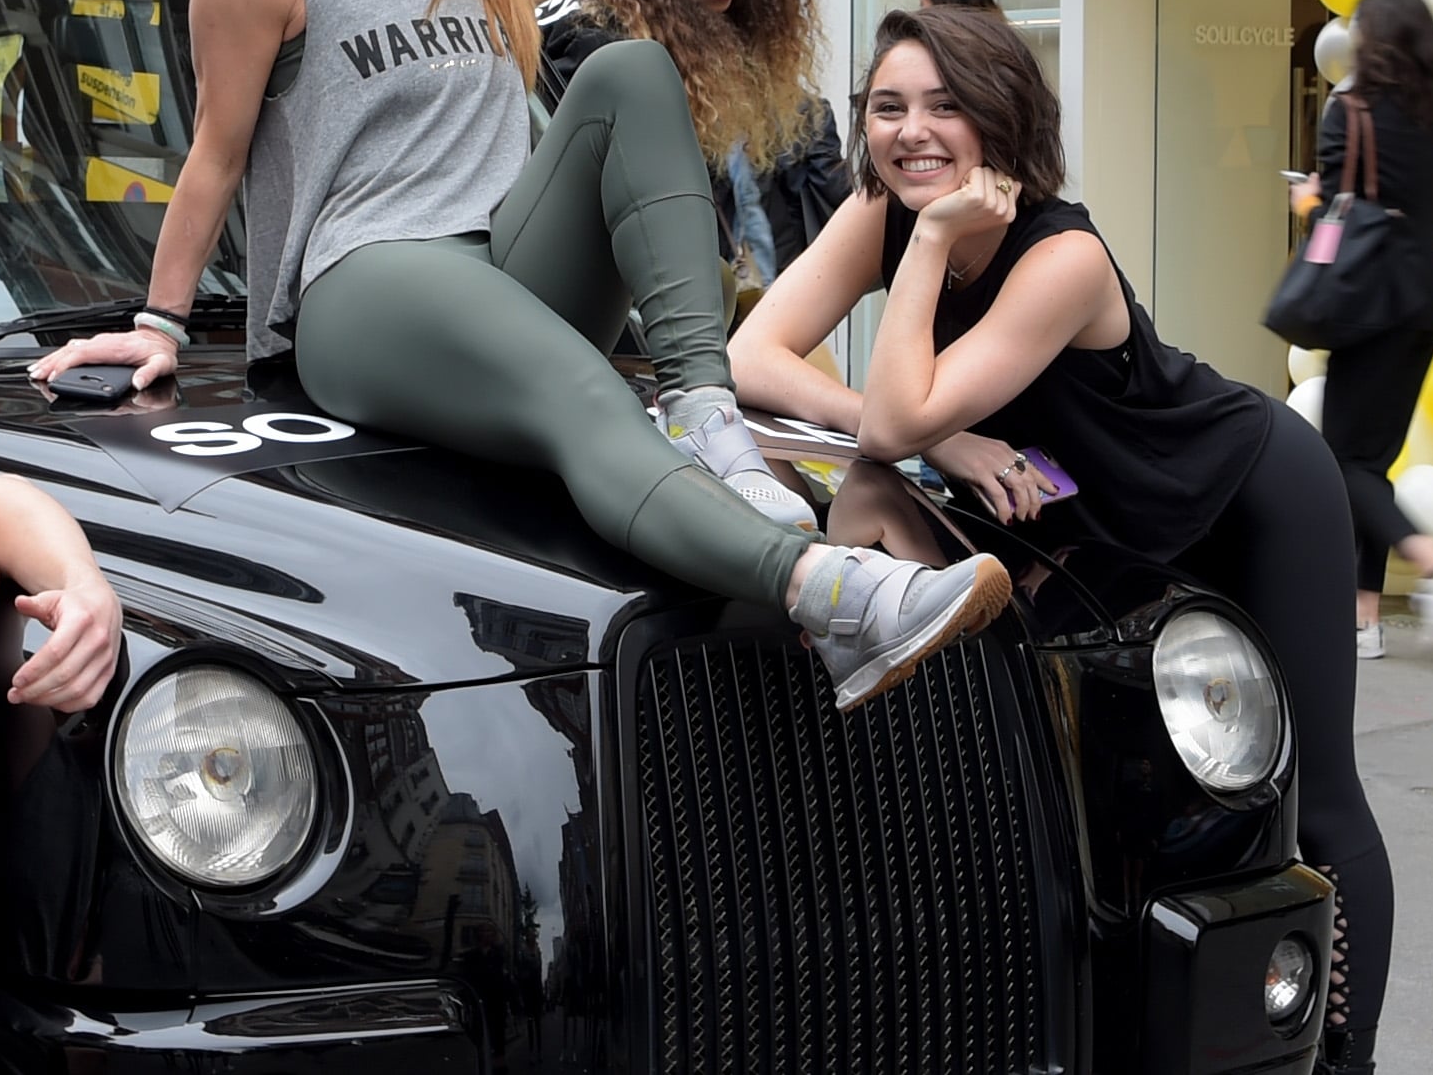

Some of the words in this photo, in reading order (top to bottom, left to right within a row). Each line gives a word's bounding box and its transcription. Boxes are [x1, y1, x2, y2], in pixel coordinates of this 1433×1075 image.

[340, 15, 514, 80] WARRIO
[1195, 26, 1295, 47] SOULCYCLE
[80, 72, 136, 109] suspension
